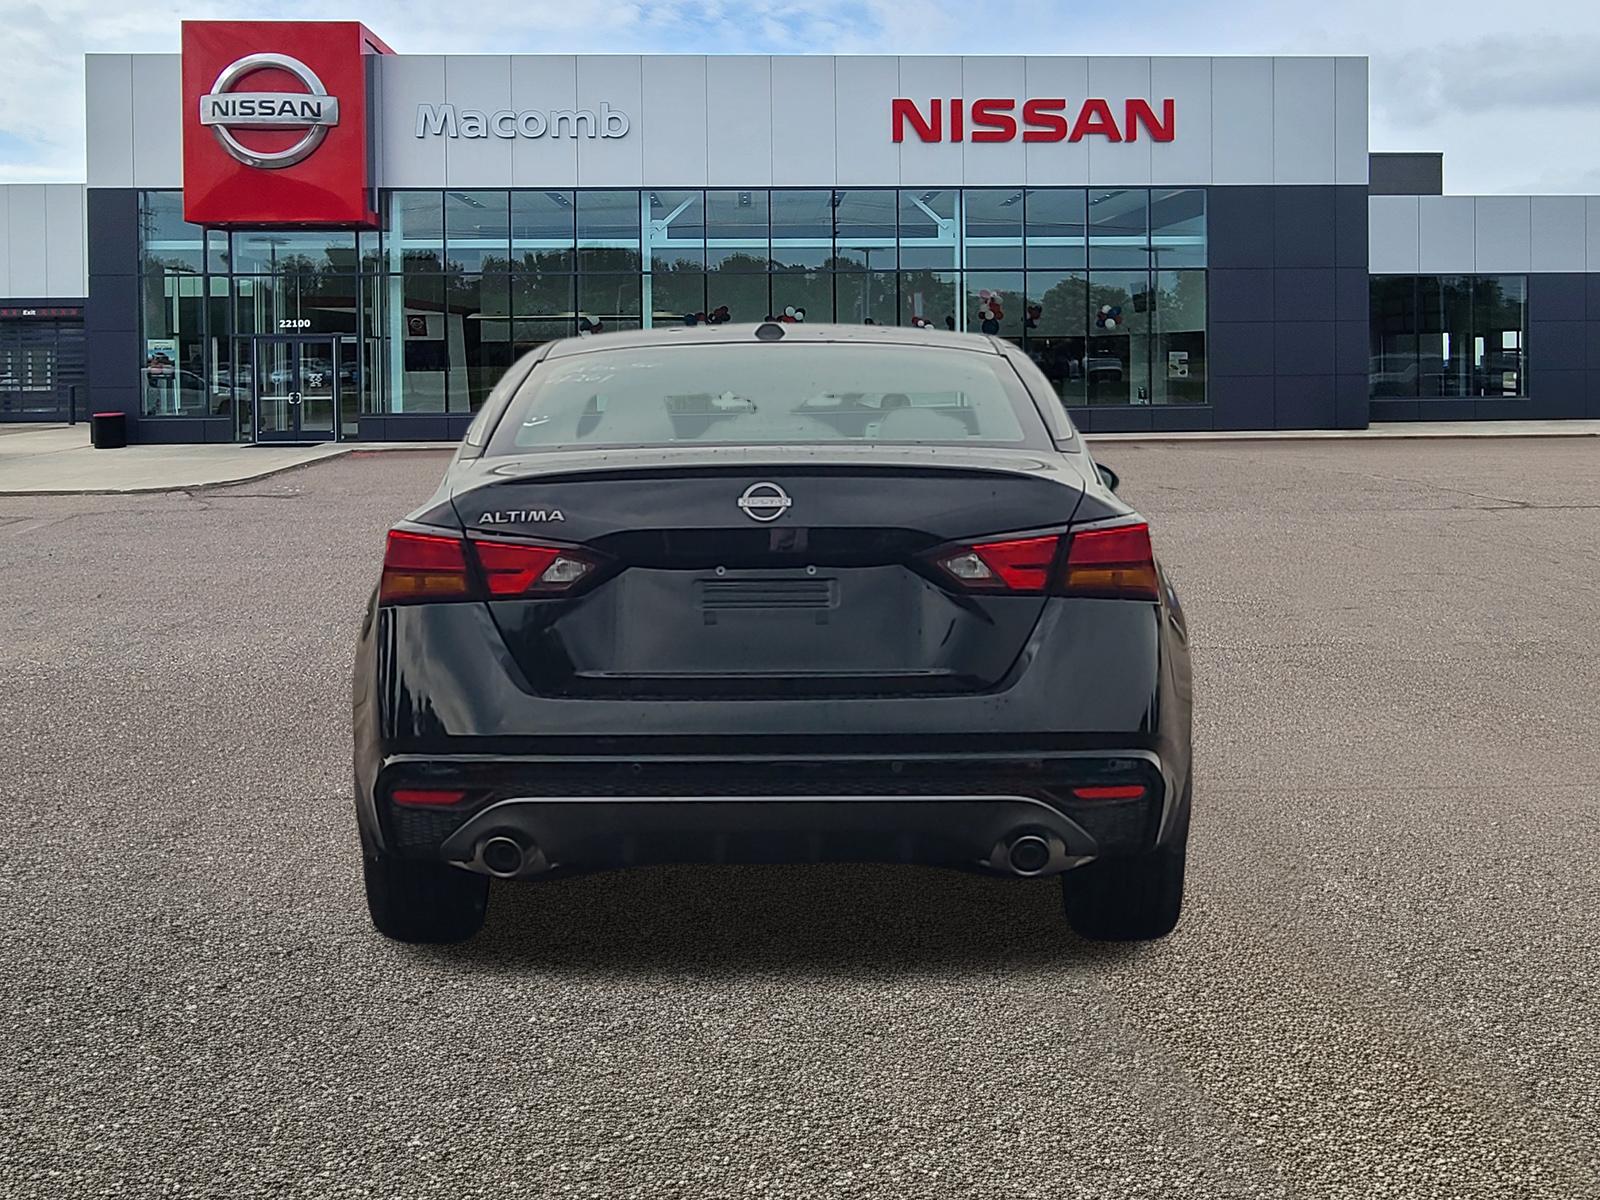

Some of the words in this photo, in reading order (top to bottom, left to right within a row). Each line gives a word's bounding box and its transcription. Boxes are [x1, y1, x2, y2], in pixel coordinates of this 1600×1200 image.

[212, 100, 321, 117] NISSAN
[415, 102, 630, 138] Macomb
[892, 98, 1175, 142] NISSAN
[279, 319, 311, 328] 22100
[479, 510, 565, 524] ALTIMA
